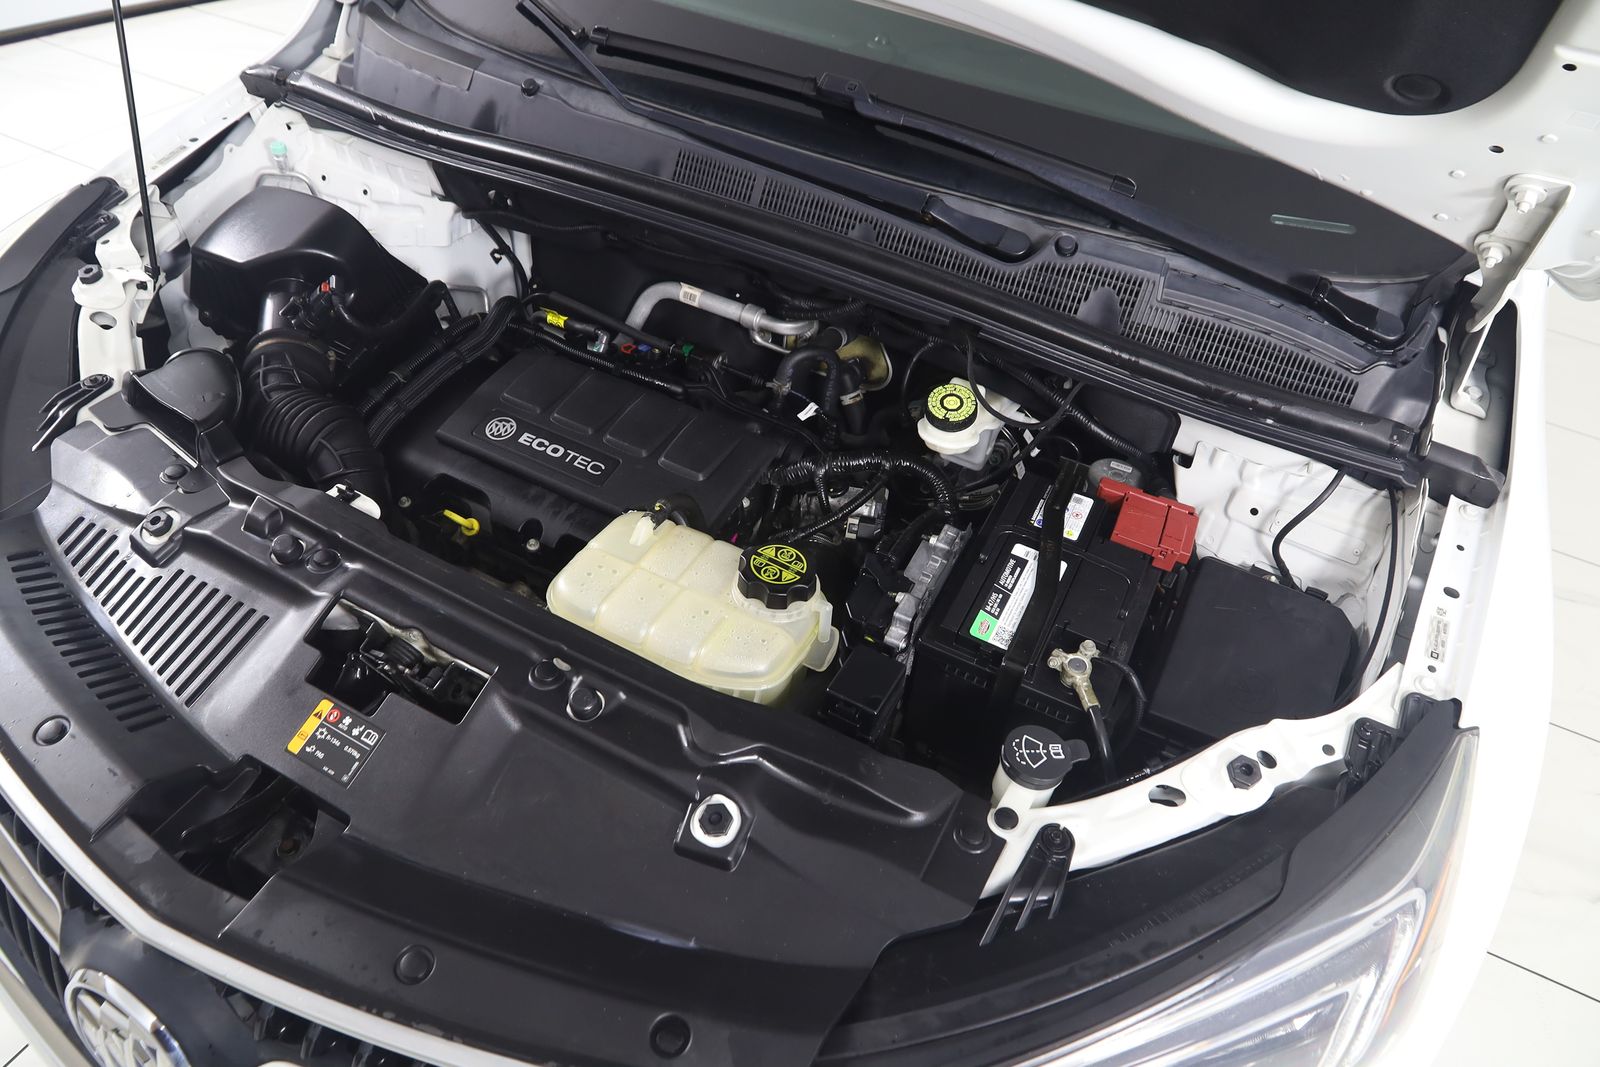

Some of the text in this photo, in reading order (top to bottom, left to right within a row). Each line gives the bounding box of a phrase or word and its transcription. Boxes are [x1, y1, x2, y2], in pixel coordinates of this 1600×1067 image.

[518, 432, 605, 475] ECOTEC
[998, 558, 1017, 586] AUTOMOTIVE
[314, 750, 325, 760] PAG
